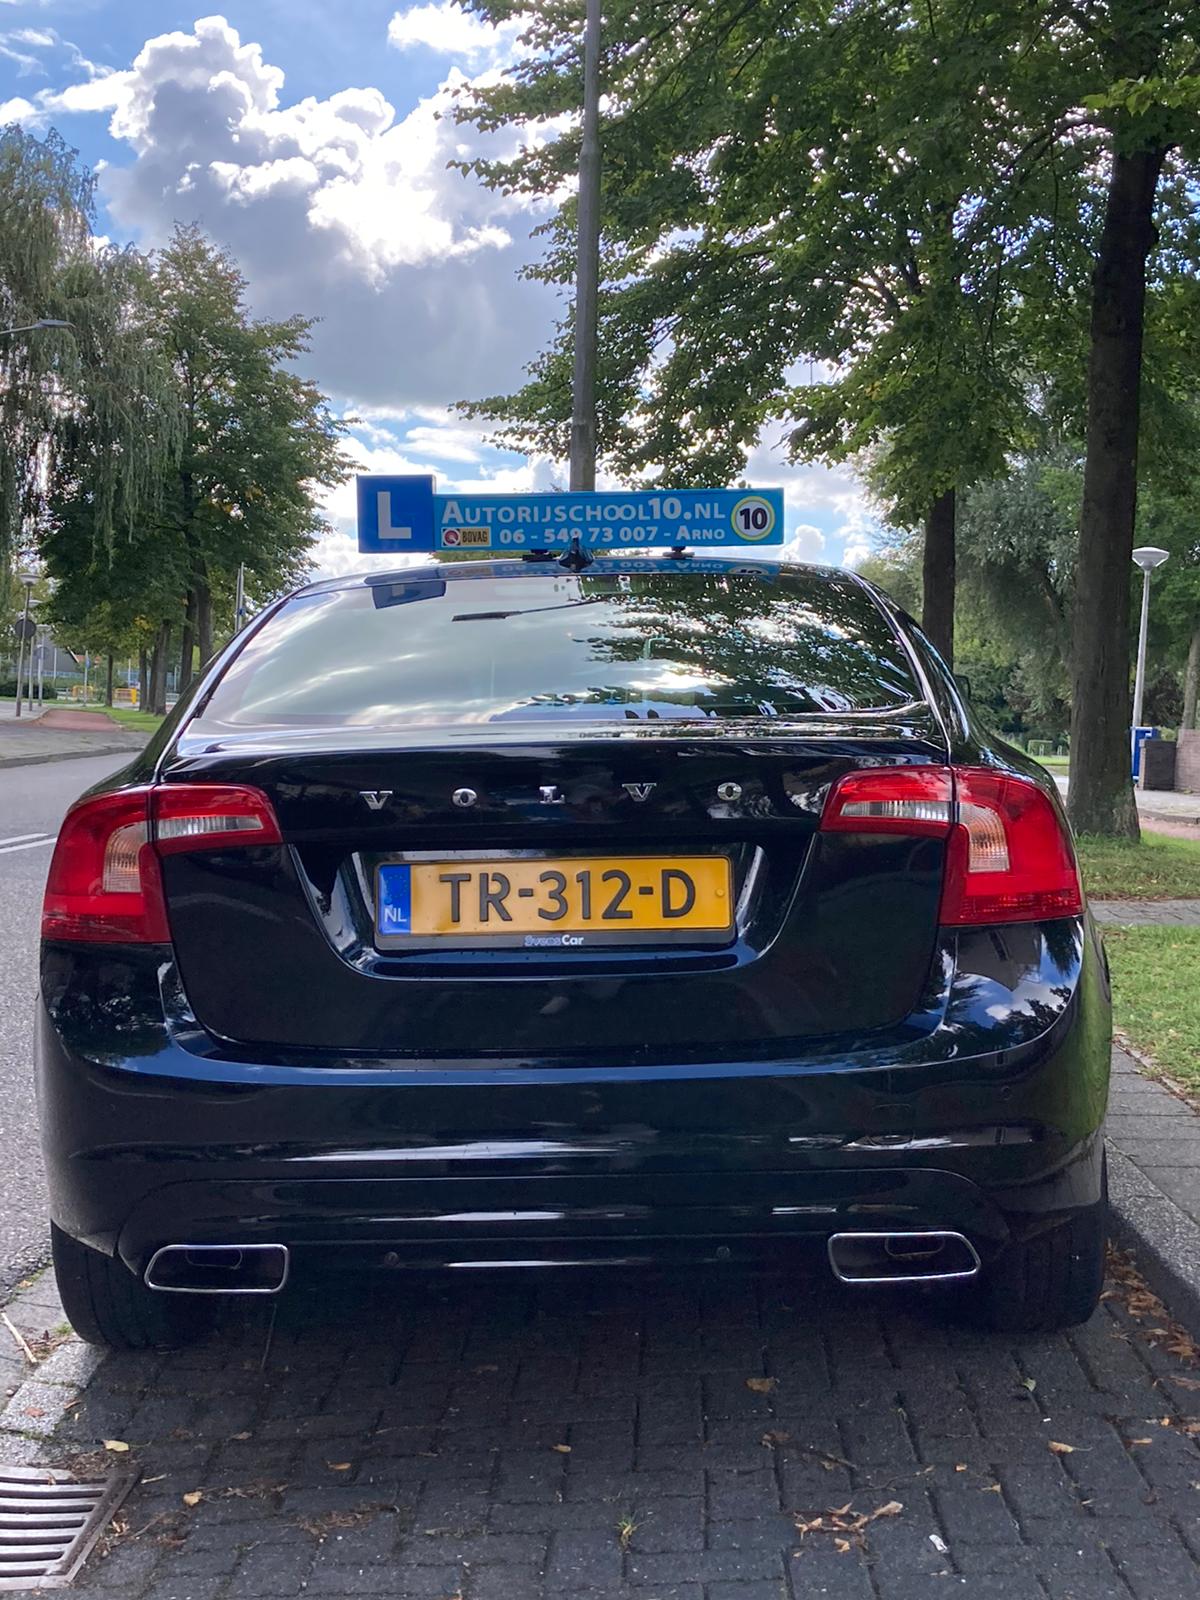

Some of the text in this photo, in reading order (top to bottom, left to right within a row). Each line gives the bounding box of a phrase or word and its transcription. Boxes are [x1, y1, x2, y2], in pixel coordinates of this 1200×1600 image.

[376, 491, 412, 540] L
[441, 497, 726, 525] AUTORIJSCHOOL10.NL
[739, 507, 768, 530] 10
[462, 530, 488, 543] BOVAG
[499, 528, 526, 545] 06
[588, 527, 614, 543] 73
[619, 526, 658, 542] 007
[675, 525, 726, 541] ARNO
[359, 781, 743, 811] VOLVO
[438, 868, 696, 923] TR-312-D
[383, 907, 407, 924] NL
